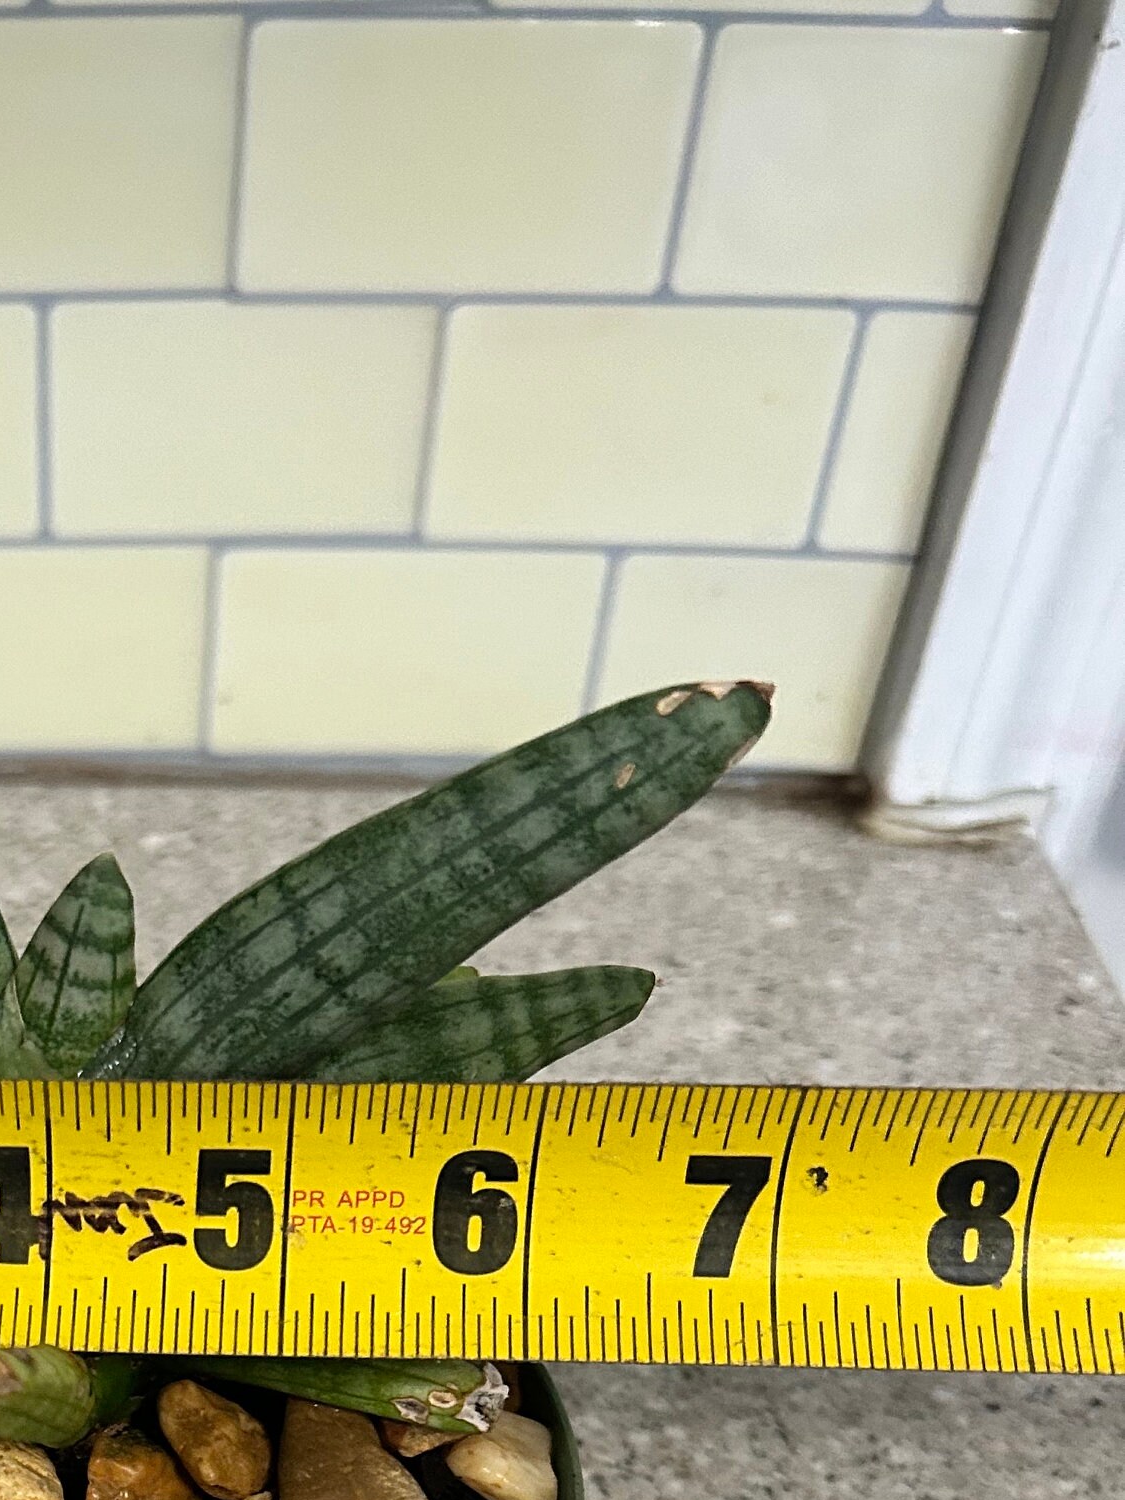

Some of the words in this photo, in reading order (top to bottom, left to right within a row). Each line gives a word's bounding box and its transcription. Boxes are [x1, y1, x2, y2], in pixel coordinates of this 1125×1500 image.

[192, 1148, 275, 1272] 5
[290, 1214, 426, 1235] PTA-19-492
[291, 1189, 325, 1209] PR
[336, 1189, 405, 1209] APPD
[431, 1149, 519, 1275] 6
[684, 1154, 773, 1278] 7
[926, 1158, 1021, 1287] 8
